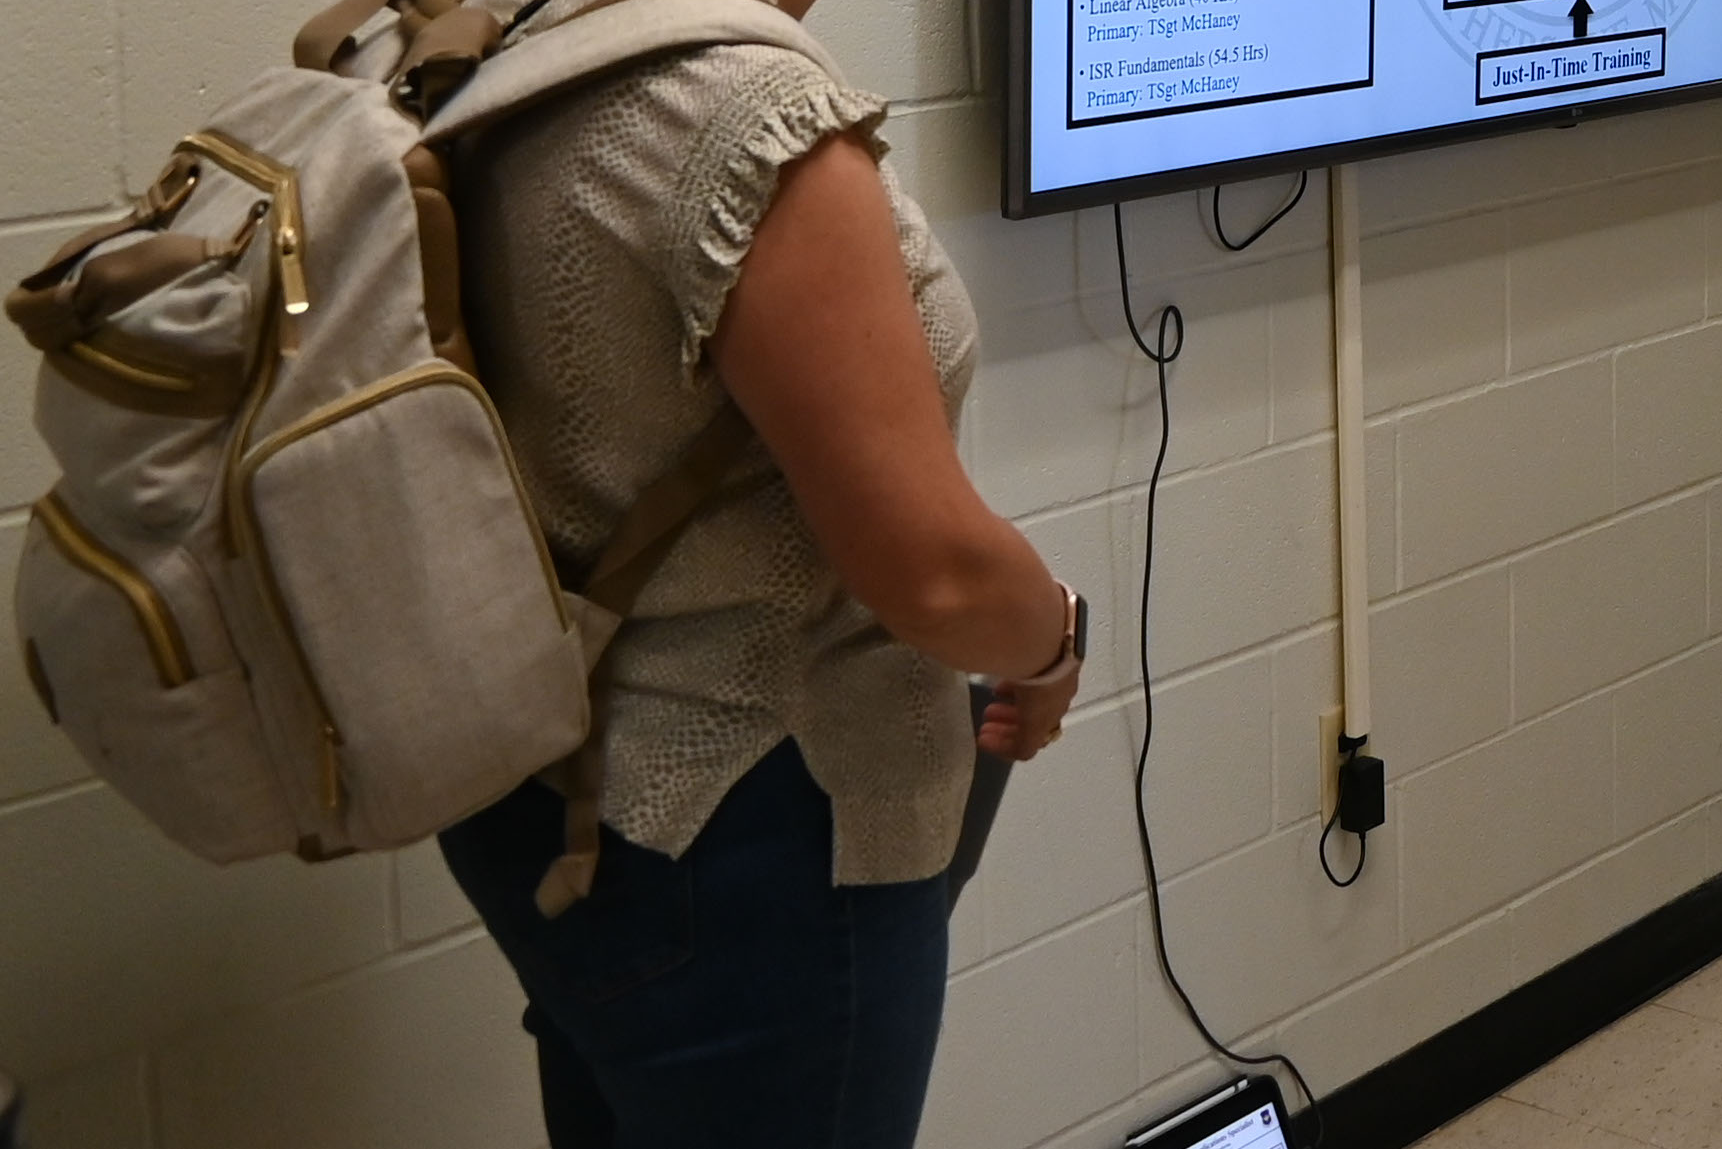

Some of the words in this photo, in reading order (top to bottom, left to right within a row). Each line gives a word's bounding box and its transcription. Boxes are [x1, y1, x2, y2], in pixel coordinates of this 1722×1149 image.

[1087, 23, 1143, 43] Primary:
[1146, 17, 1178, 39] TSgt
[1181, 12, 1240, 32] McHaney
[1089, 61, 1115, 81] ISR
[1117, 50, 1205, 77] Fundamentals
[1208, 46, 1239, 69] (54.5
[1242, 43, 1268, 62] Hrs)
[1492, 56, 1588, 87] Just-In-Time
[1591, 46, 1651, 72] Training
[1086, 88, 1143, 108] Primary:
[1146, 82, 1177, 102] TSgt
[1180, 75, 1240, 96] McHaney
